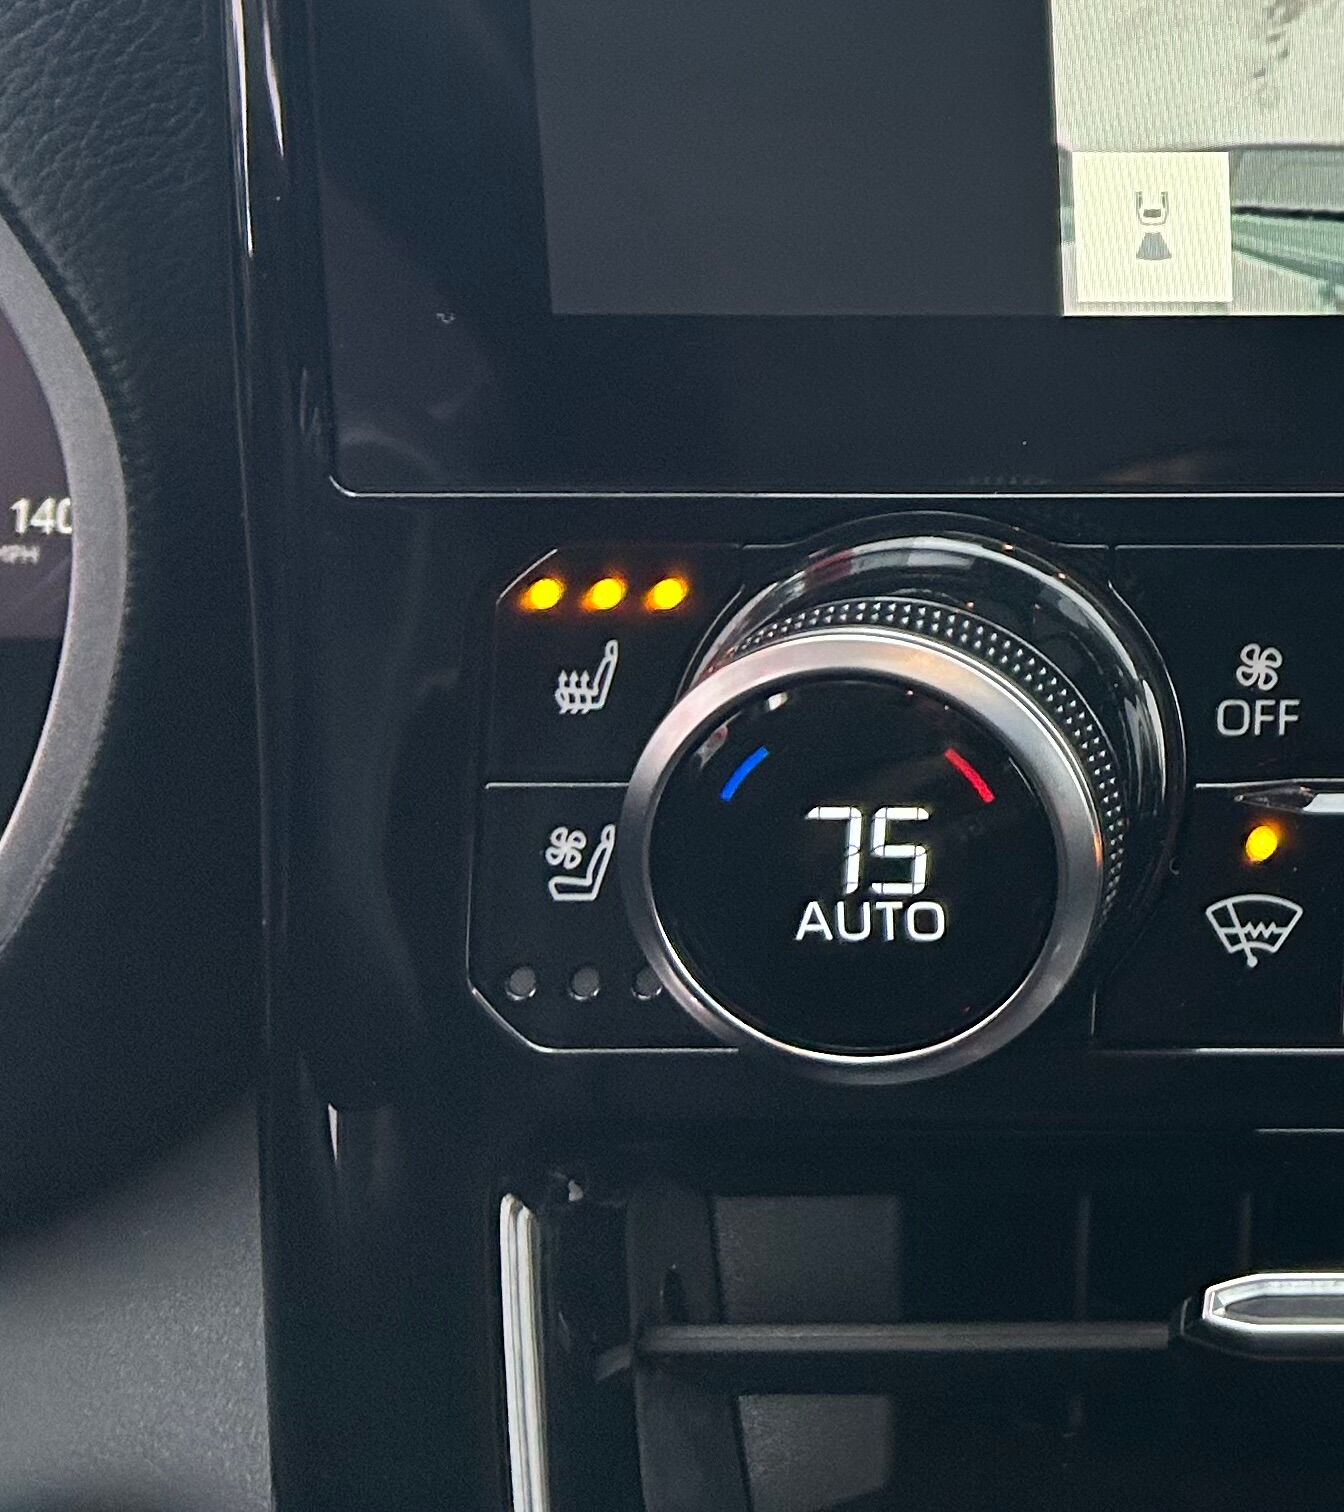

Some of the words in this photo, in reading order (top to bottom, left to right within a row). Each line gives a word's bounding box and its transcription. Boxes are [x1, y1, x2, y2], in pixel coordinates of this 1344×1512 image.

[1215, 697, 1301, 738] OFF
[804, 805, 930, 897] 75
[794, 900, 946, 943] AUTO
